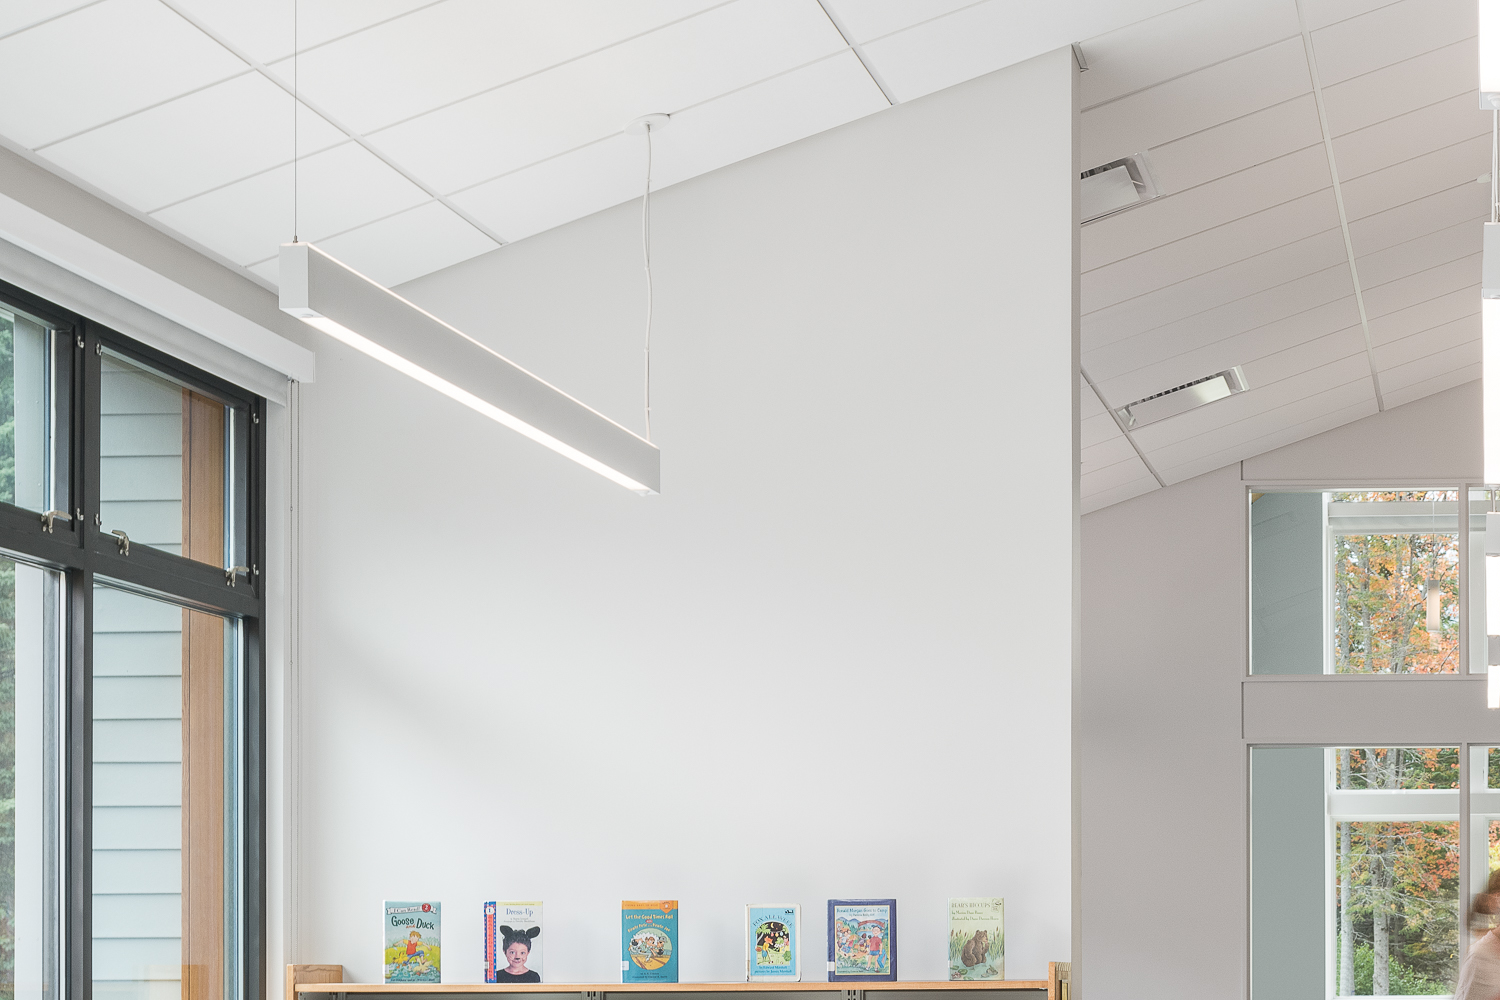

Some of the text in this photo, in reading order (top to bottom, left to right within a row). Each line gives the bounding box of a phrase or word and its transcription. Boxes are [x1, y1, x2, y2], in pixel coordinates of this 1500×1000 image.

[506, 908, 533, 917] Dress-Up
[391, 916, 414, 926] Goose
[416, 918, 434, 930] Duck
